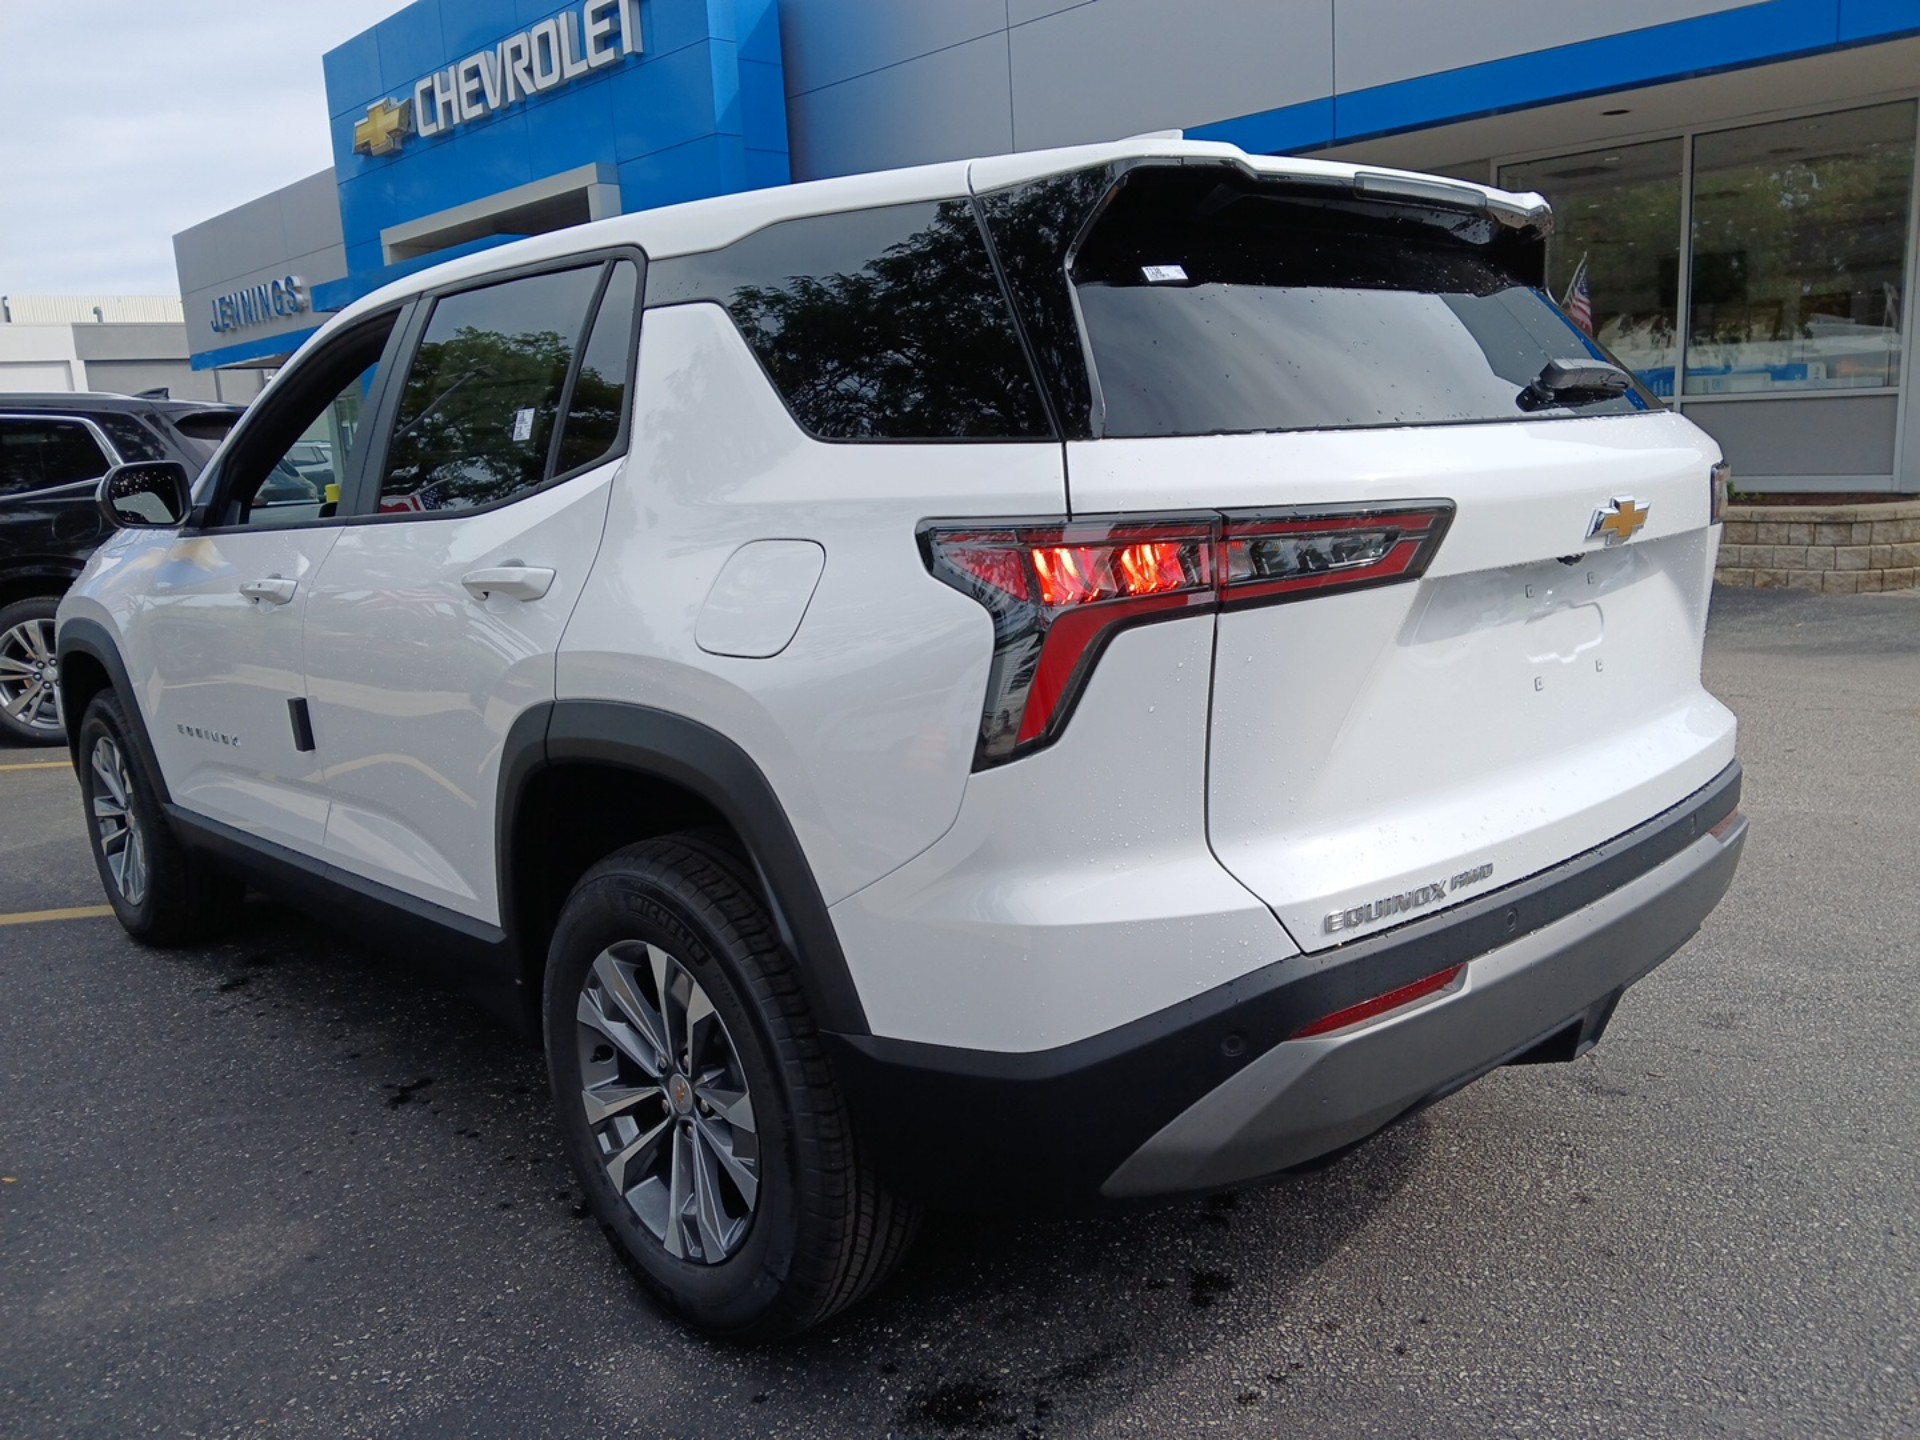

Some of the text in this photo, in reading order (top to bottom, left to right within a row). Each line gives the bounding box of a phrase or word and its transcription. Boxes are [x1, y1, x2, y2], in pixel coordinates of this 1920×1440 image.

[414, 0, 644, 138] CHEVROLET
[210, 275, 304, 333] JENNINGS
[628, 895, 706, 963] MICHELIN
[1324, 862, 1494, 934] EQUINOX AWD
